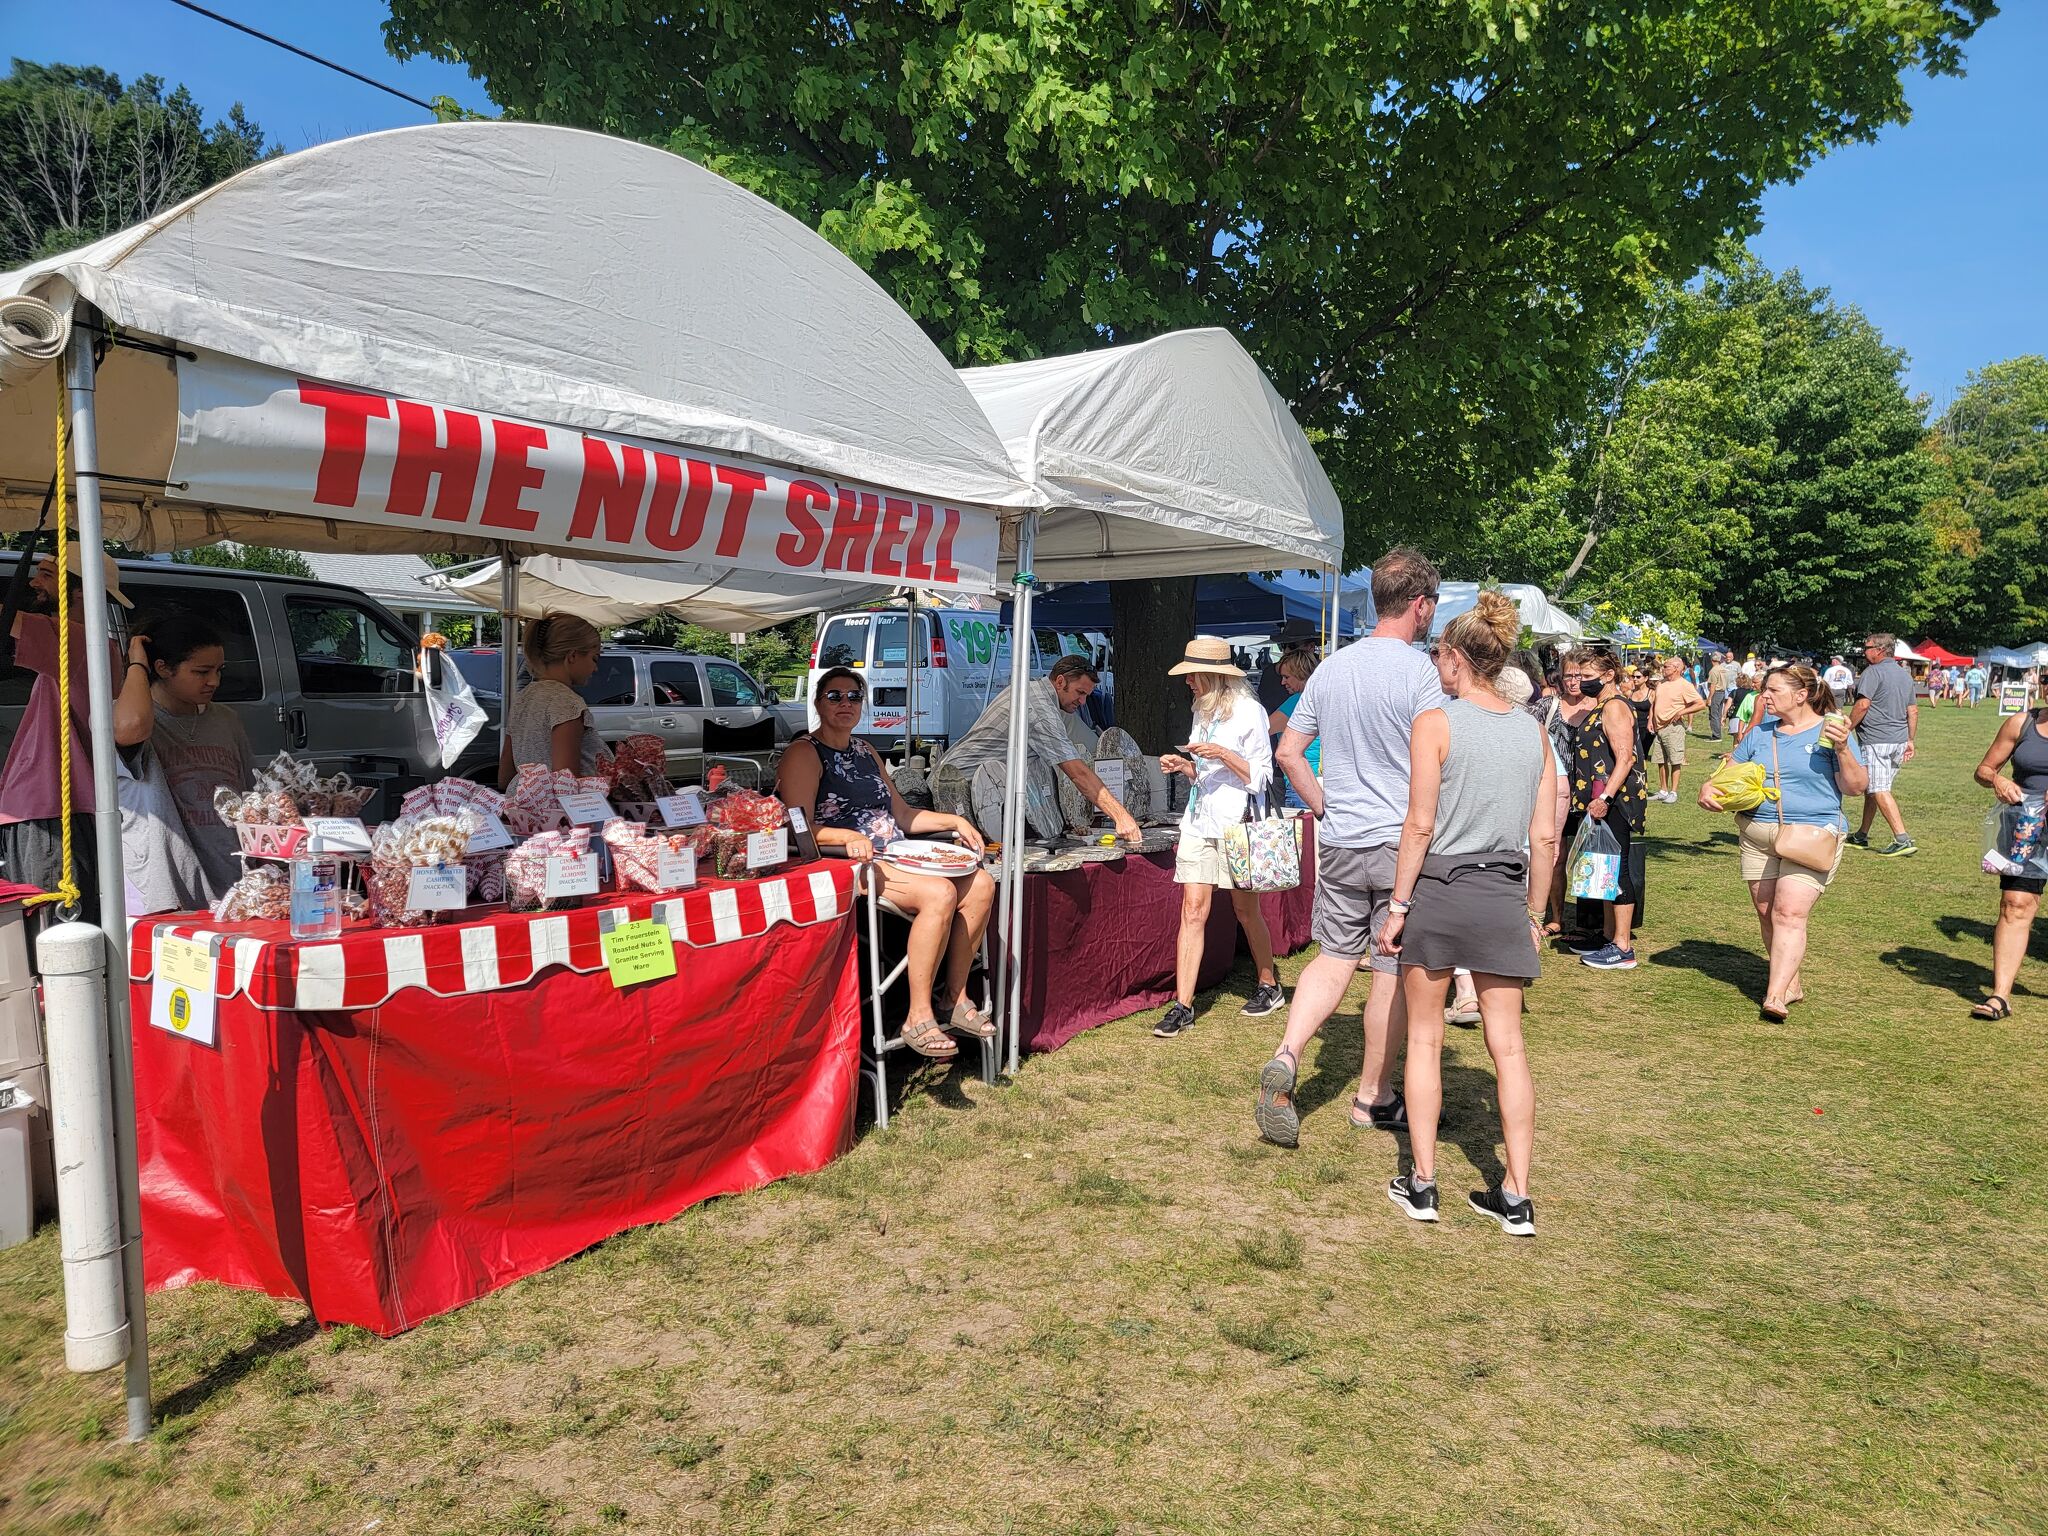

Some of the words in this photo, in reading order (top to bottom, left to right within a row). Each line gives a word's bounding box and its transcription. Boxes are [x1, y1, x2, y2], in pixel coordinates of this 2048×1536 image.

[297, 379, 549, 531] THE
[569, 438, 767, 558] NUT
[776, 479, 960, 583] SHELL
[845, 618, 864, 626] Need
[878, 617, 897, 625] Van?
[974, 681, 986, 689] Share
[630, 922, 640, 930] 2-3
[626, 929, 660, 941] Feuerstein
[612, 943, 639, 954] Roasted
[640, 940, 656, 948] Nuts
[615, 954, 638, 964] Granite
[640, 949, 665, 959] Serving
[633, 962, 650, 971] Ware
